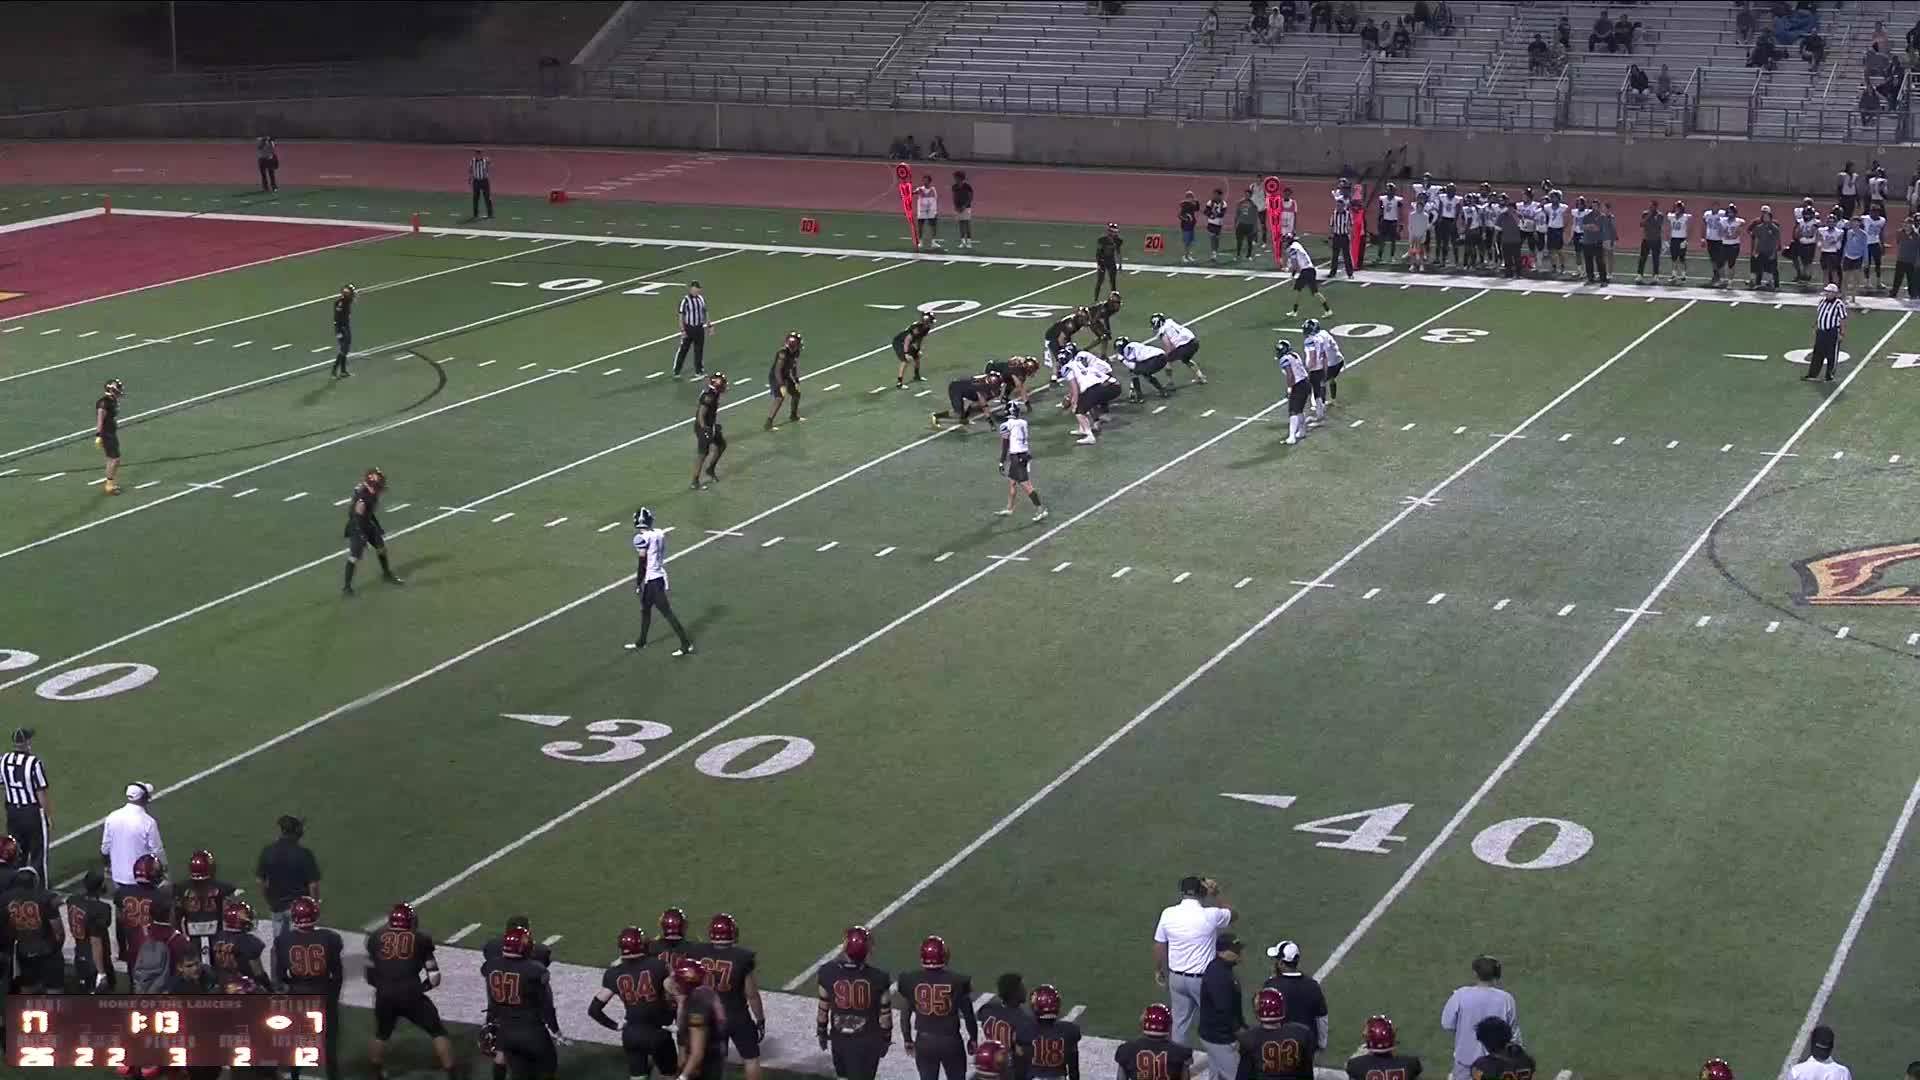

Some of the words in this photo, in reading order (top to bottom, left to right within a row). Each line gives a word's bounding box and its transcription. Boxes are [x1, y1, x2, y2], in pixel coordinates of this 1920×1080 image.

[1146, 236, 1160, 249] 20
[1330, 323, 1491, 344] 30
[541, 718, 816, 779] 30
[1293, 803, 1594, 869] 40
[290, 944, 328, 977] 96
[380, 931, 416, 960] 30
[489, 970, 521, 1005] 97
[616, 970, 656, 1006] 84
[833, 979, 871, 1010] 90
[914, 983, 952, 1016] 95
[1032, 1037, 1064, 1067] 18
[1136, 1050, 1169, 1080] 91
[1262, 1039, 1299, 1073] 93
